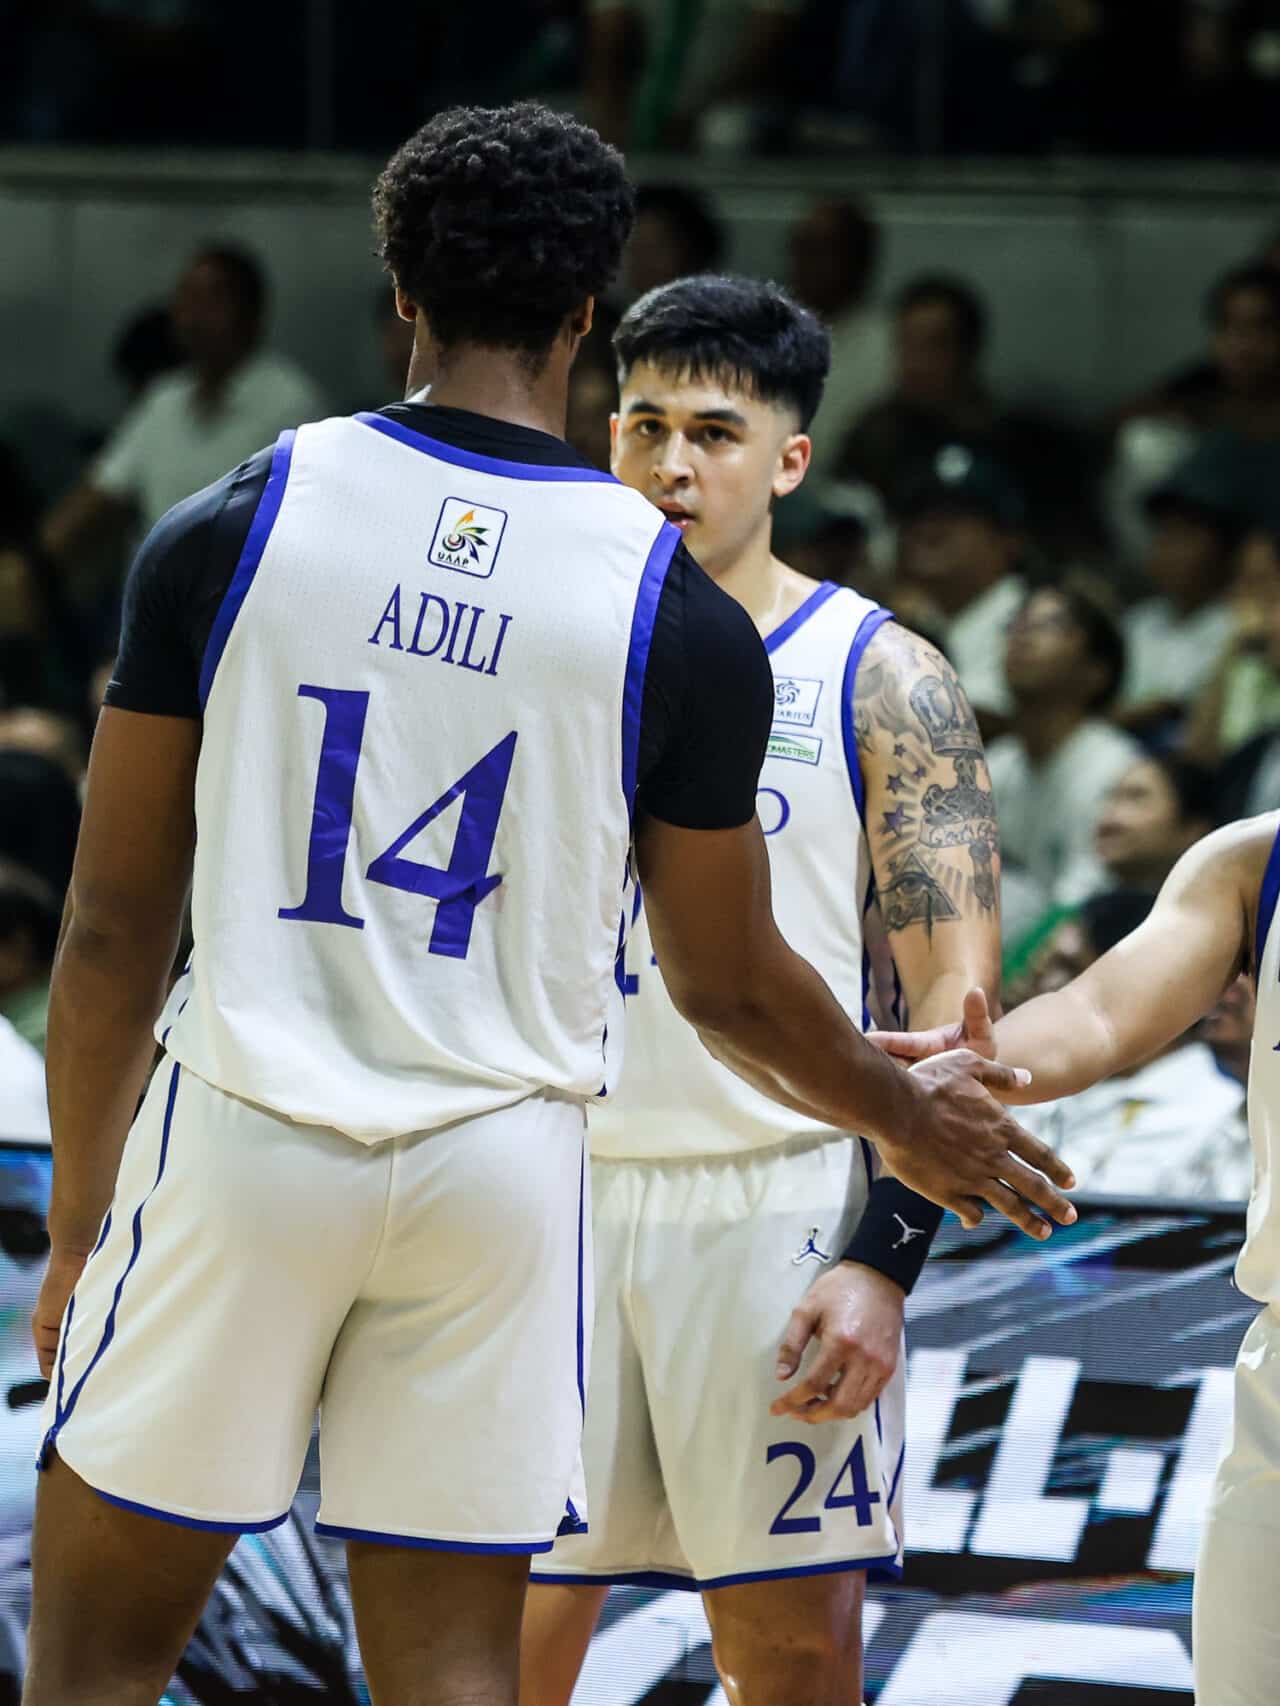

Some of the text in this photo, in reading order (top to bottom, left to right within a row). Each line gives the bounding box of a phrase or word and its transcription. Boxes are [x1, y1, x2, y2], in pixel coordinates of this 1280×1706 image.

[437, 551, 470, 566] UAAP
[367, 583, 513, 676] ADILI
[277, 683, 518, 960] 14
[766, 1433, 880, 1535] 24
